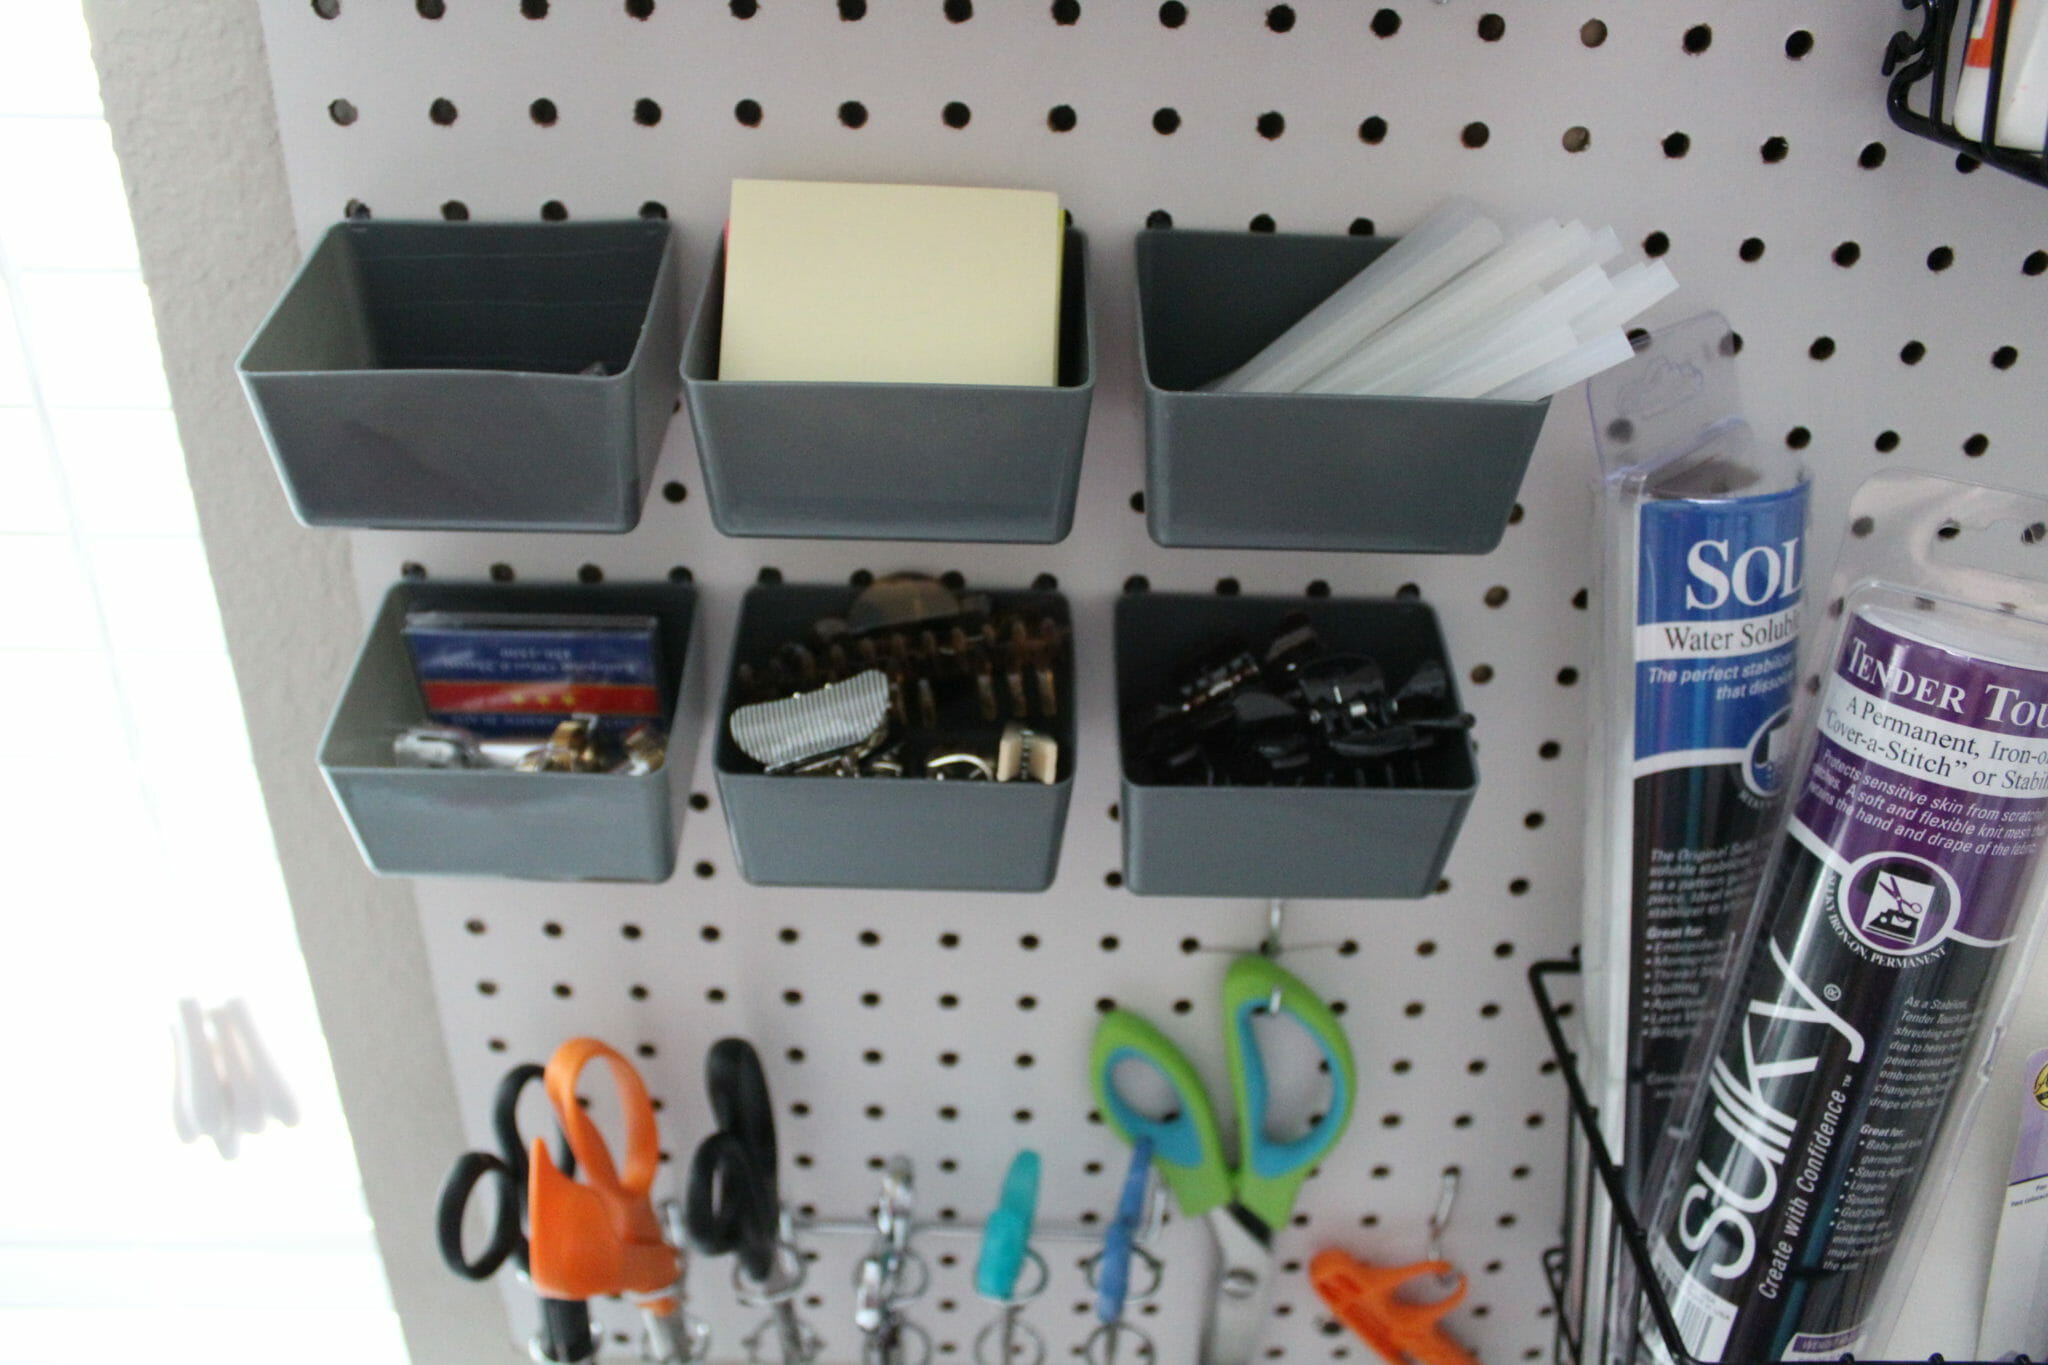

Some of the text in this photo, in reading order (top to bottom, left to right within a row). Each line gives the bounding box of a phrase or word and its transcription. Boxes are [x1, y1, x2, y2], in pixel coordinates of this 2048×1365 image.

[1664, 626, 1734, 652] Water
[1650, 667, 1677, 684] The
[1680, 664, 1738, 686] perfect
[1716, 684, 1746, 700] that
[1847, 636, 1967, 715] TENDER
[1846, 695, 1858, 716] A
[1861, 700, 1980, 759] Permanent,
[1972, 769, 1998, 787] or
[1845, 783, 1857, 798] A
[1857, 787, 1886, 810] soft
[1886, 800, 1916, 822] and
[1918, 810, 1976, 836] flexible
[1978, 824, 2003, 840] knit
[1861, 773, 1928, 806] sensitive
[1929, 795, 1964, 815] skin
[1965, 803, 2000, 821] from
[1835, 796, 1854, 817] the
[1855, 806, 1893, 832] hand
[1893, 822, 1926, 843] and
[1927, 832, 1974, 855] drape
[1974, 841, 1991, 855] of
[1869, 944, 1946, 969] PERMANENT
[1860, 1123, 1890, 1138] Great
[1757, 1088, 1848, 1301] Create with Confidence
